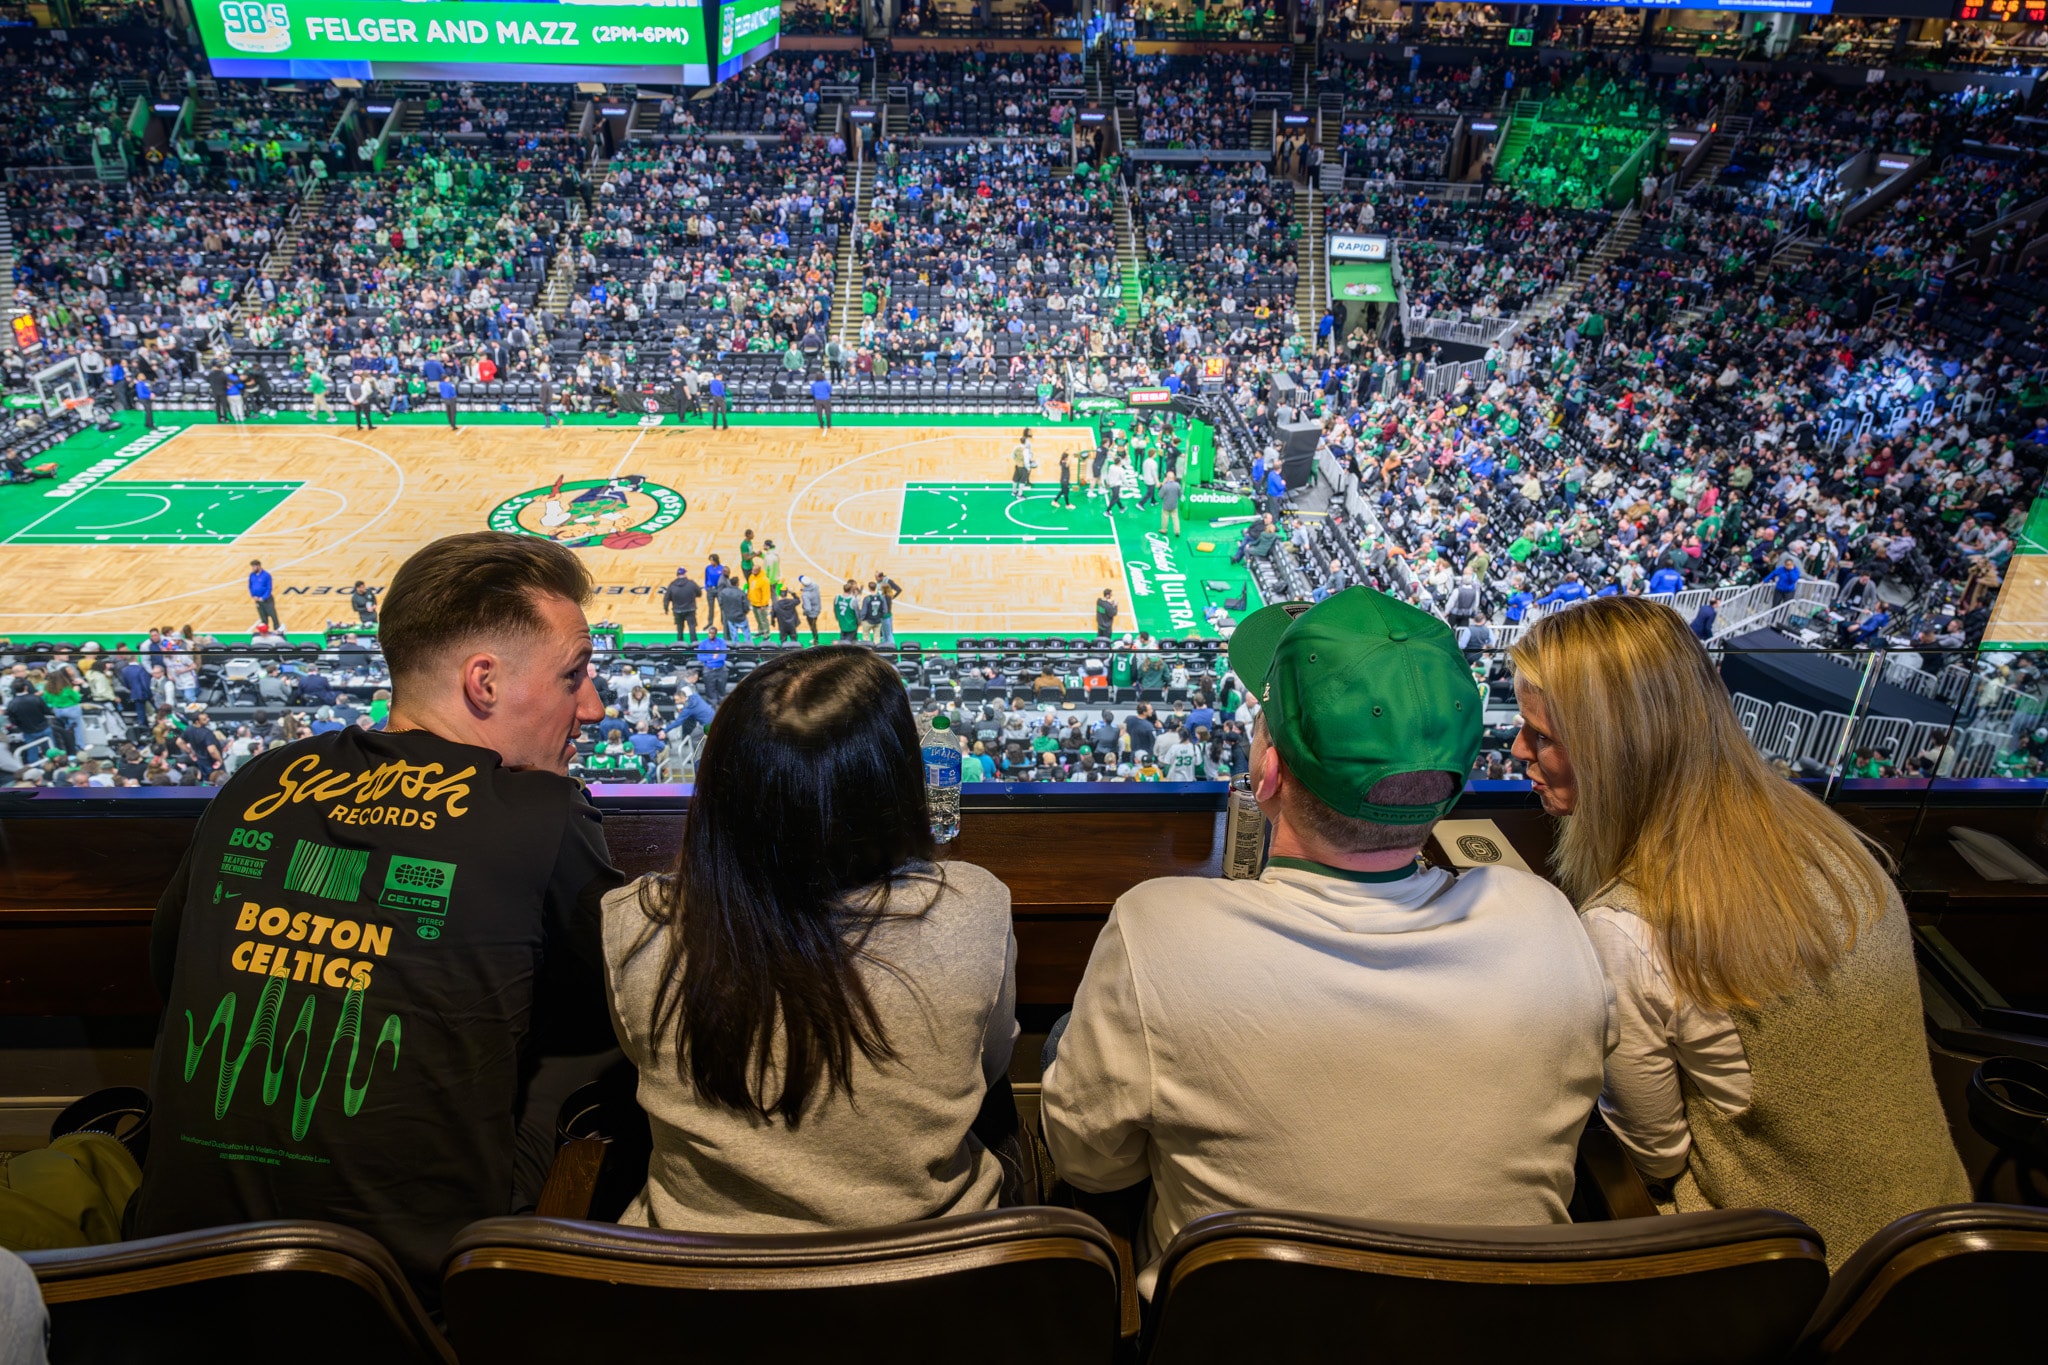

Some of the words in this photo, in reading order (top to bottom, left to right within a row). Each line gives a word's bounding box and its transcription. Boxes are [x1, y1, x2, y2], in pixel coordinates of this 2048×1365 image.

[304, 17, 418, 43] FELGER
[426, 19, 489, 44] AND
[496, 21, 580, 45] MAZZ
[591, 25, 689, 45] (2PM-6PM)
[43, 458, 129, 497] BOSTON
[113, 425, 182, 457] CELTICS
[1189, 489, 1239, 504] coinbase
[641, 489, 681, 532] BOSTON
[1161, 582, 1197, 630] ULTRA
[1175, 755, 1193, 767] 33
[242, 753, 477, 822] Swoosh
[327, 804, 438, 830] RECORDS
[228, 827, 274, 851] BOS
[220, 863, 263, 876] RECORDINGS
[223, 855, 266, 869] BEAVERTON
[387, 893, 440, 909] CELTICS
[235, 901, 393, 957] BOSTON
[417, 916, 445, 927] STEREO
[231, 941, 375, 991] CELTICS
